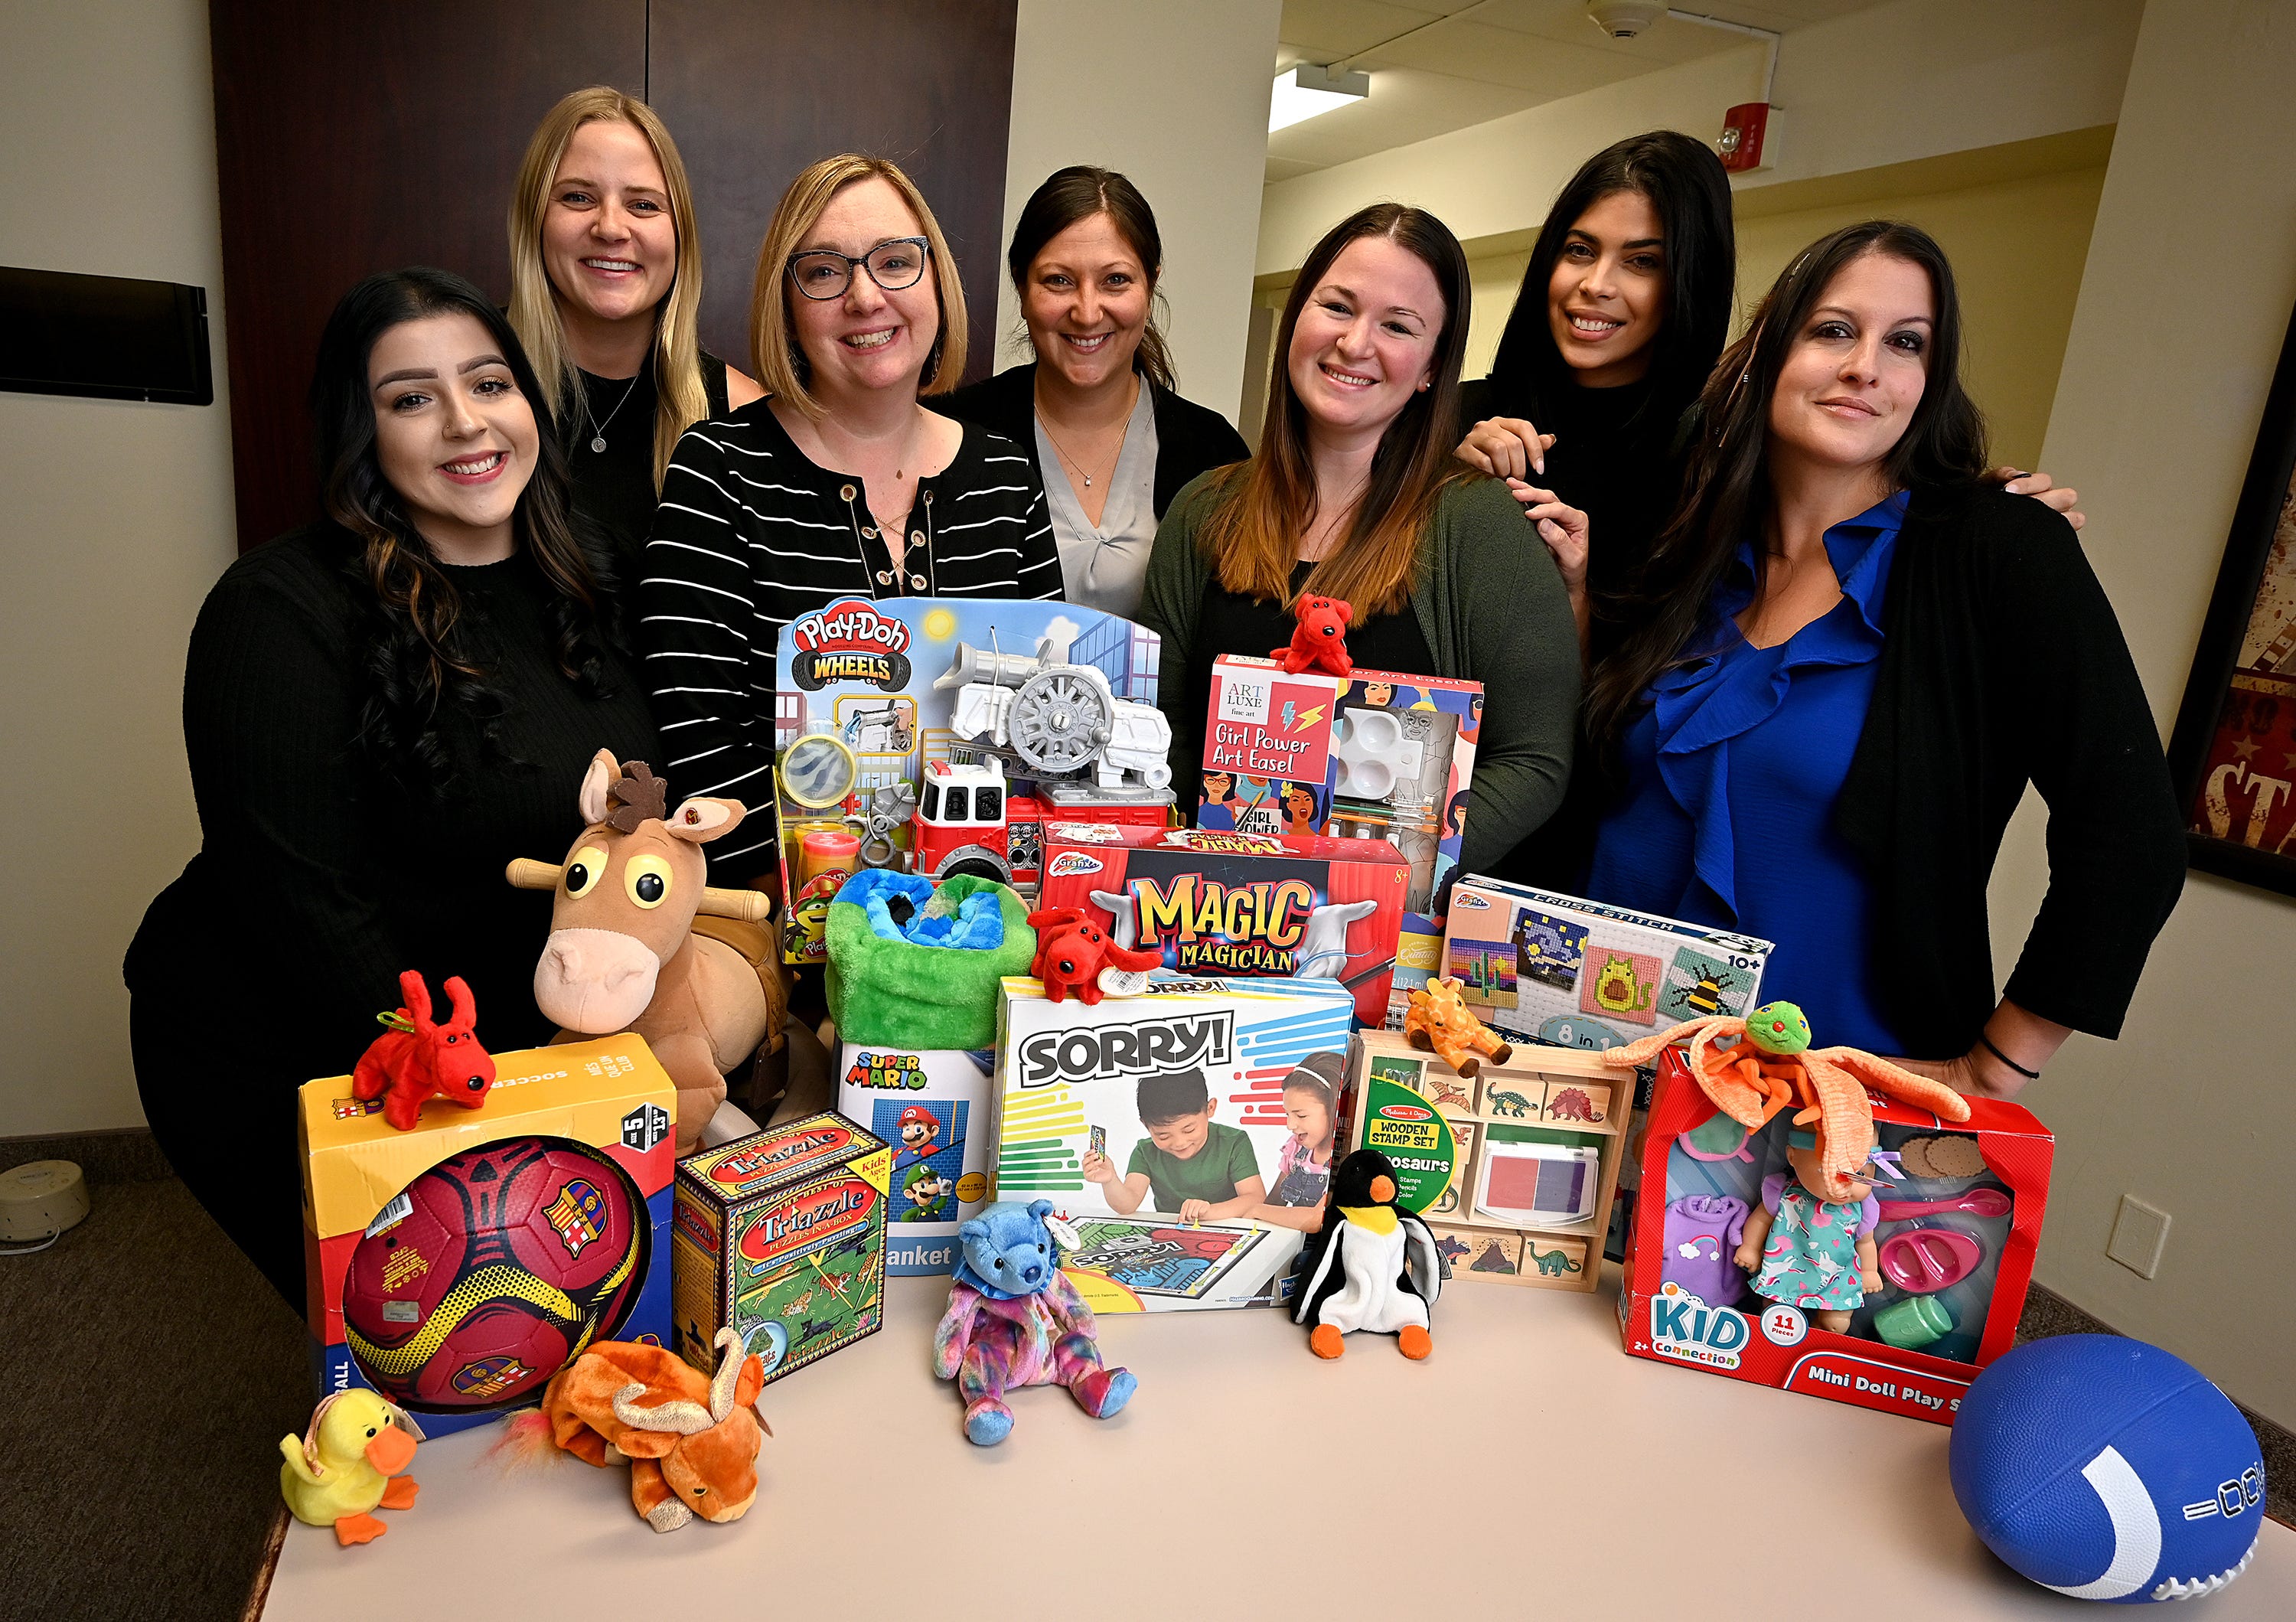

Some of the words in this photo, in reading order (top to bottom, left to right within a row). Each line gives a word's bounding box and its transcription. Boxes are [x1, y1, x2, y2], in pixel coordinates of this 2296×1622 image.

[796, 611, 906, 651] Play-Doh
[814, 655, 892, 680] WHEELS
[1228, 683, 1264, 697] ART
[1227, 695, 1262, 708] LUXE
[1231, 708, 1244, 716] fine
[1215, 723, 1249, 747] Girl
[1255, 727, 1311, 753] Power
[1212, 744, 1243, 768] Art
[1248, 749, 1294, 774] Easel
[1244, 823, 1279, 834] OWER
[1190, 837, 1278, 854] MAGIC
[1059, 857, 1094, 868] Grafix
[1394, 869, 1408, 883] 8+
[1133, 876, 1311, 947] MAGIC
[1533, 893, 1596, 913] CROSS
[1602, 910, 1675, 932] STITCH
[1180, 942, 1293, 971] MAGICIAN
[1727, 954, 1761, 970] 10+
[1557, 1023, 1574, 1044] 8
[1578, 1033, 1594, 1048] in
[1600, 1036, 1610, 1052] 1
[1025, 1017, 1227, 1082] SORRY!
[615, 1056, 634, 1072] CLUB
[857, 1053, 919, 1070] SUPER
[846, 1066, 927, 1090] MARIO
[1385, 1107, 1409, 1116] Melissa
[624, 1118, 644, 1131] 5
[652, 1116, 666, 1131] 13
[1381, 1121, 1430, 1135] WOODEN
[735, 1147, 756, 1158] THE
[757, 1135, 785, 1147] BEST
[1371, 1132, 1411, 1145] STAMP
[1414, 1136, 1435, 1147] SET
[722, 1132, 838, 1177] Triazzle
[749, 1158, 791, 1178] PUZZLES
[792, 1144, 835, 1162] IN-A-BOX
[861, 1153, 889, 1173] Kids'
[868, 1166, 886, 1177] Ages
[874, 1173, 886, 1184] 3-7
[1400, 1177, 1422, 1185] Stamps
[778, 1196, 799, 1212] THE
[803, 1184, 829, 1199] BEST
[833, 1180, 846, 1189] OF
[572, 1203, 589, 1226] FCB
[759, 1189, 865, 1245] Triazzle
[768, 1229, 811, 1252] PUZZLES
[812, 1212, 853, 1235] IN-A-BOX
[761, 1257, 777, 1269] It's
[777, 1242, 820, 1263] Positively
[821, 1225, 859, 1245] Puzzling!
[886, 1245, 951, 1266] anket
[1075, 1240, 1182, 1268] SORRY!
[1655, 1299, 1745, 1350] KID
[1771, 1327, 1794, 1337] Pieces
[1773, 1314, 1795, 1330] 11
[785, 1329, 843, 1363] Triazzle
[1633, 1341, 1649, 1351] 2+
[1655, 1342, 1736, 1367] Connection
[1808, 1365, 1851, 1387] Mini
[1855, 1376, 1896, 1398] Doll
[1901, 1386, 1944, 1411] Play
